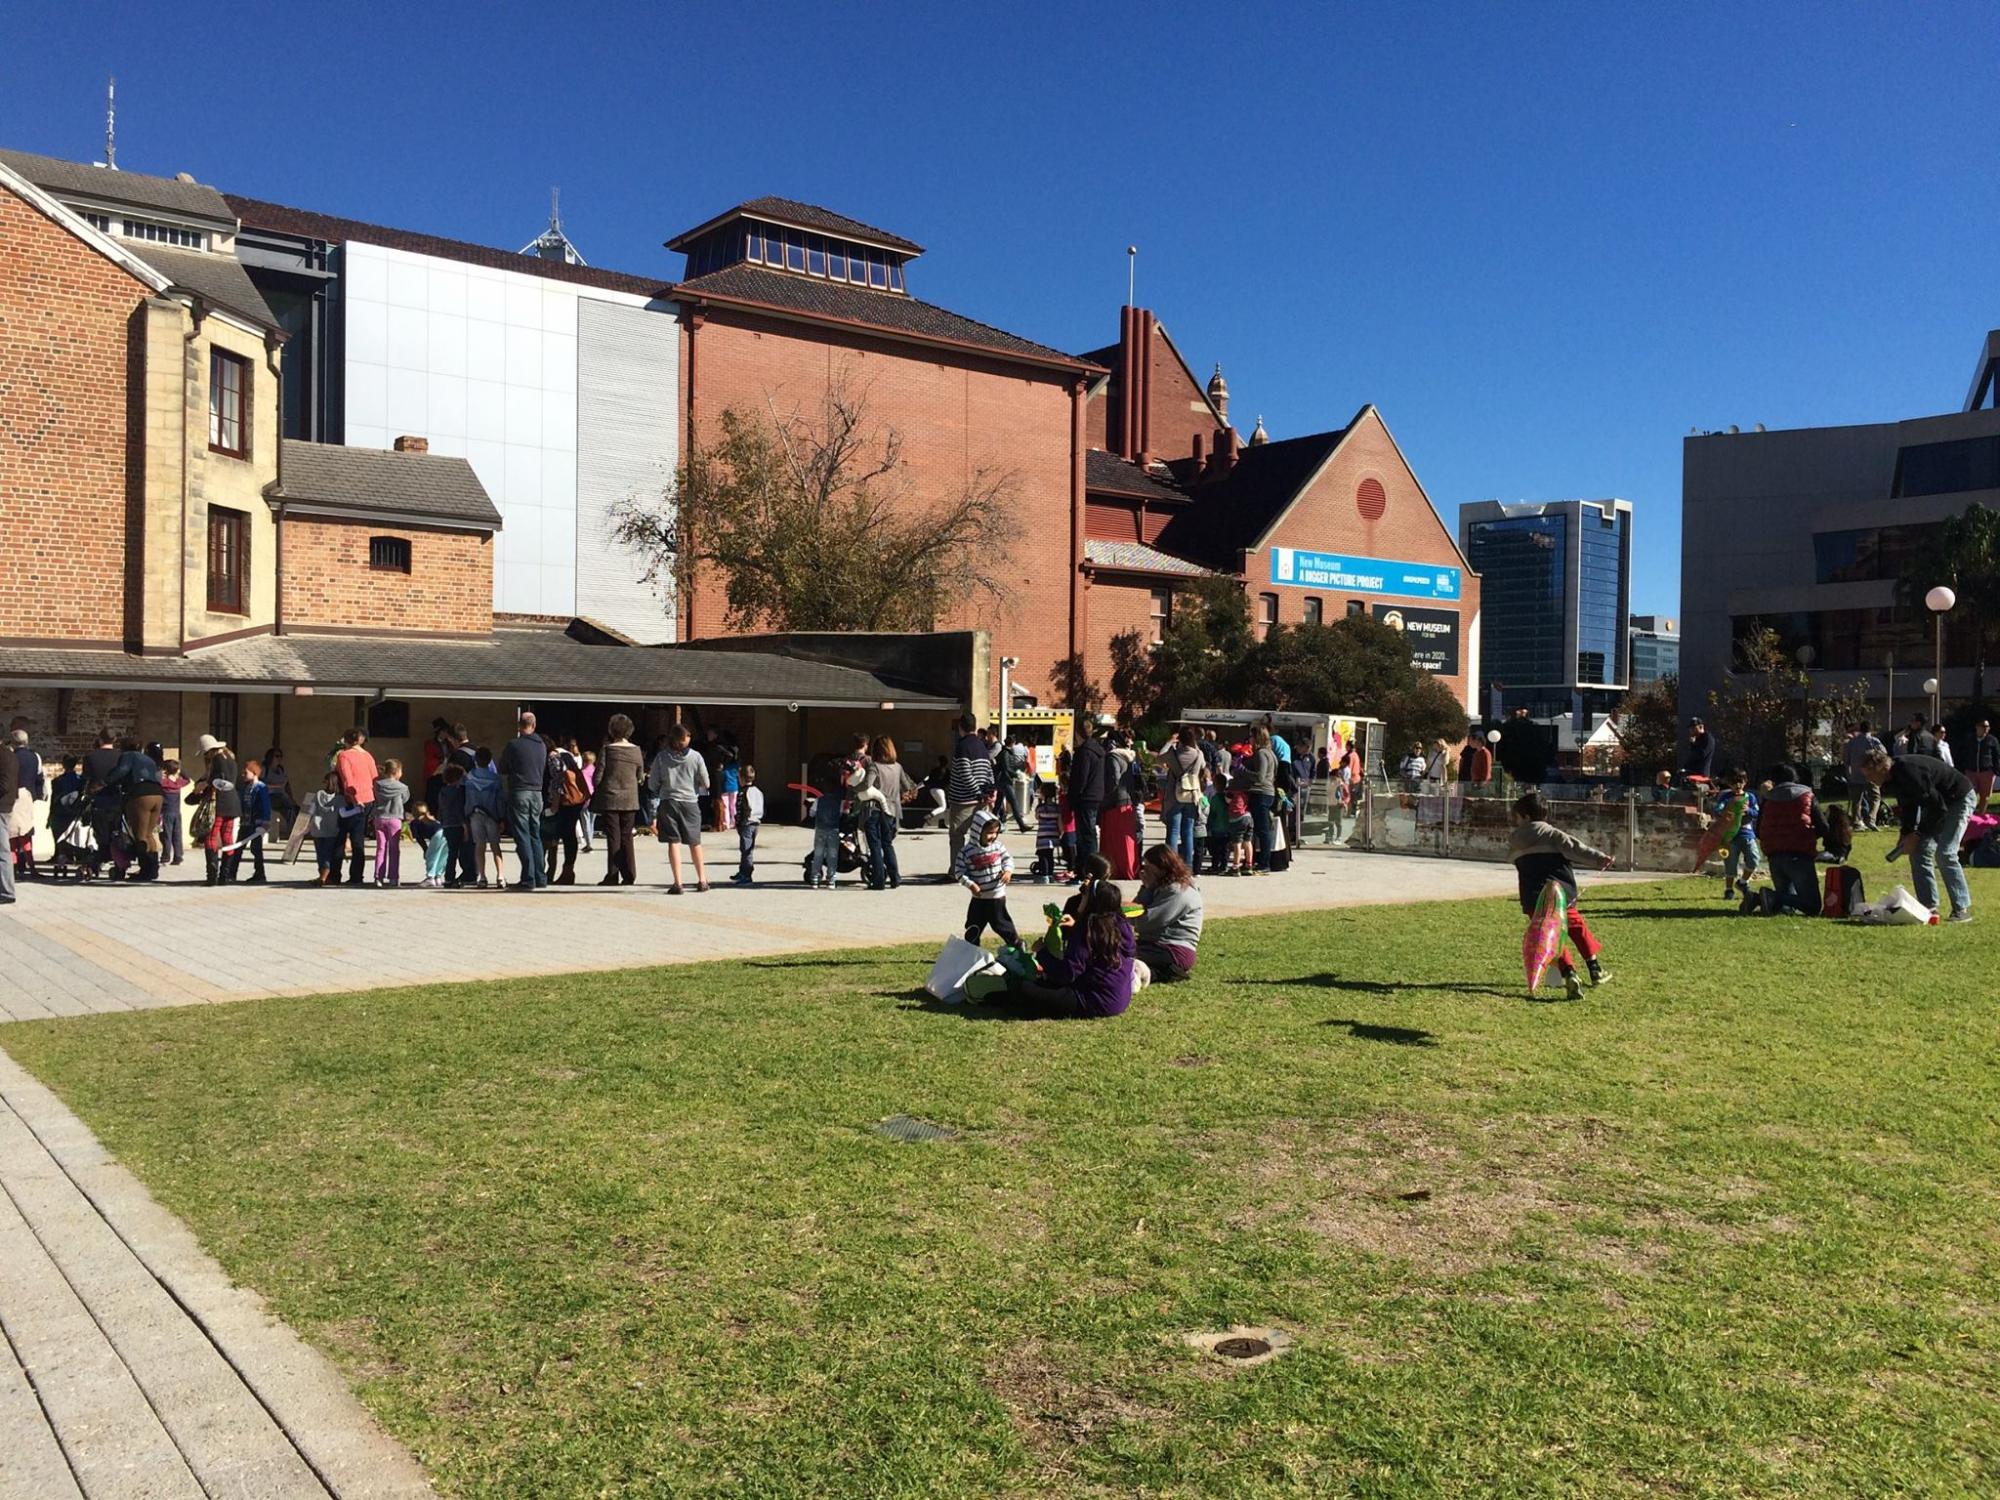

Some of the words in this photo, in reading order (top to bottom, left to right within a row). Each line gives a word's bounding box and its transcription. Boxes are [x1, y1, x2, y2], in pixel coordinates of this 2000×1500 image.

[1299, 555, 1313, 568] New
[1314, 557, 1341, 571] Museum
[1299, 569, 1305, 581] A
[1305, 570, 1329, 584] BIGGER
[1329, 572, 1356, 587] PICTURE
[1357, 575, 1384, 590] PROJECT
[1407, 621, 1422, 632] NEW
[1423, 622, 1451, 633] MUSEUM
